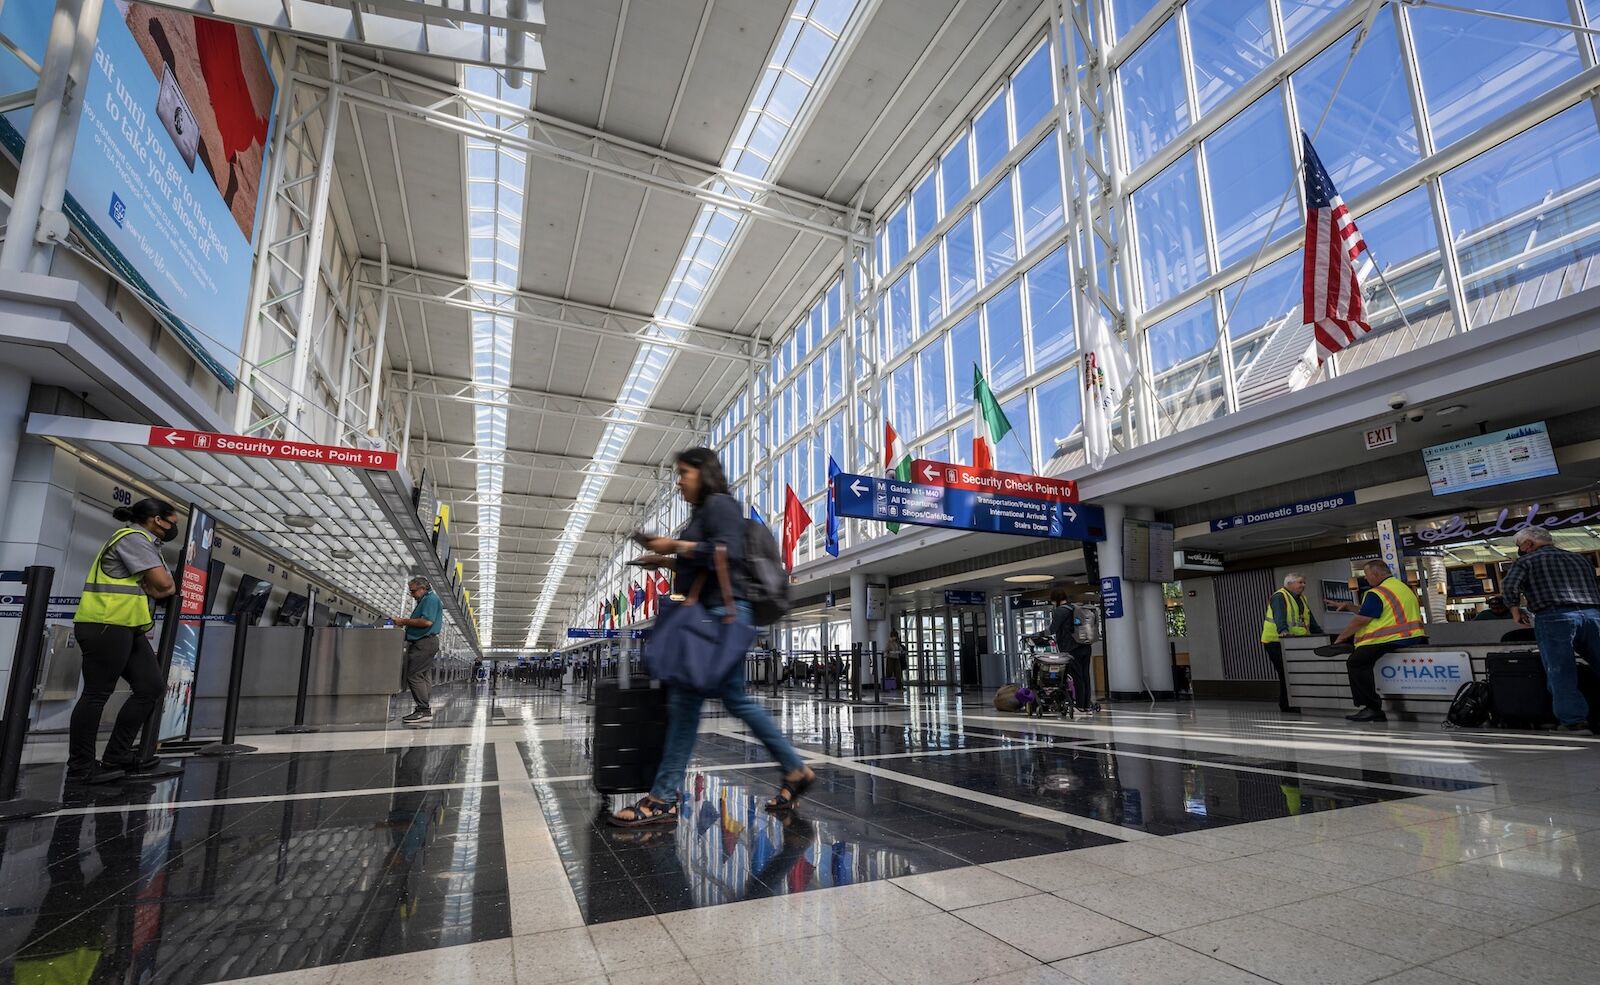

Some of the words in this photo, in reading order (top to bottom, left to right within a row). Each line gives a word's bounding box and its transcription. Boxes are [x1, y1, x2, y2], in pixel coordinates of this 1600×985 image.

[106, 92, 119, 121] to
[121, 115, 147, 164] take
[147, 157, 173, 201] your
[171, 195, 199, 241] shoes
[116, 76, 146, 133] until
[145, 125, 166, 166] you
[166, 160, 183, 192] get
[183, 184, 193, 208] to
[193, 200, 208, 230] the
[207, 220, 230, 264] beach
[1367, 427, 1393, 444] EXIT
[216, 438, 275, 455] Security
[280, 445, 323, 458] Check
[328, 450, 362, 462] Point
[367, 455, 383, 465] 10
[890, 485, 911, 494] Gates
[925, 489, 940, 498] M40
[962, 472, 1002, 489] Security
[1005, 480, 1033, 493] Check
[1035, 484, 1058, 495] Point
[1060, 486, 1071, 497] 10
[113, 486, 131, 506] 39B
[891, 496, 900, 504] All
[901, 497, 938, 510] Departures
[977, 496, 1041, 512] Transportation/Parking
[989, 508, 1025, 520] International
[1026, 513, 1047, 521] Arrivals
[1247, 507, 1292, 523] Domestic
[1296, 497, 1344, 513] Baggage
[1014, 521, 1031, 530] Stairs
[1032, 524, 1049, 532] Down
[1417, 502, 1600, 544] Goddes
[1381, 665, 1461, 679] O'HARE
